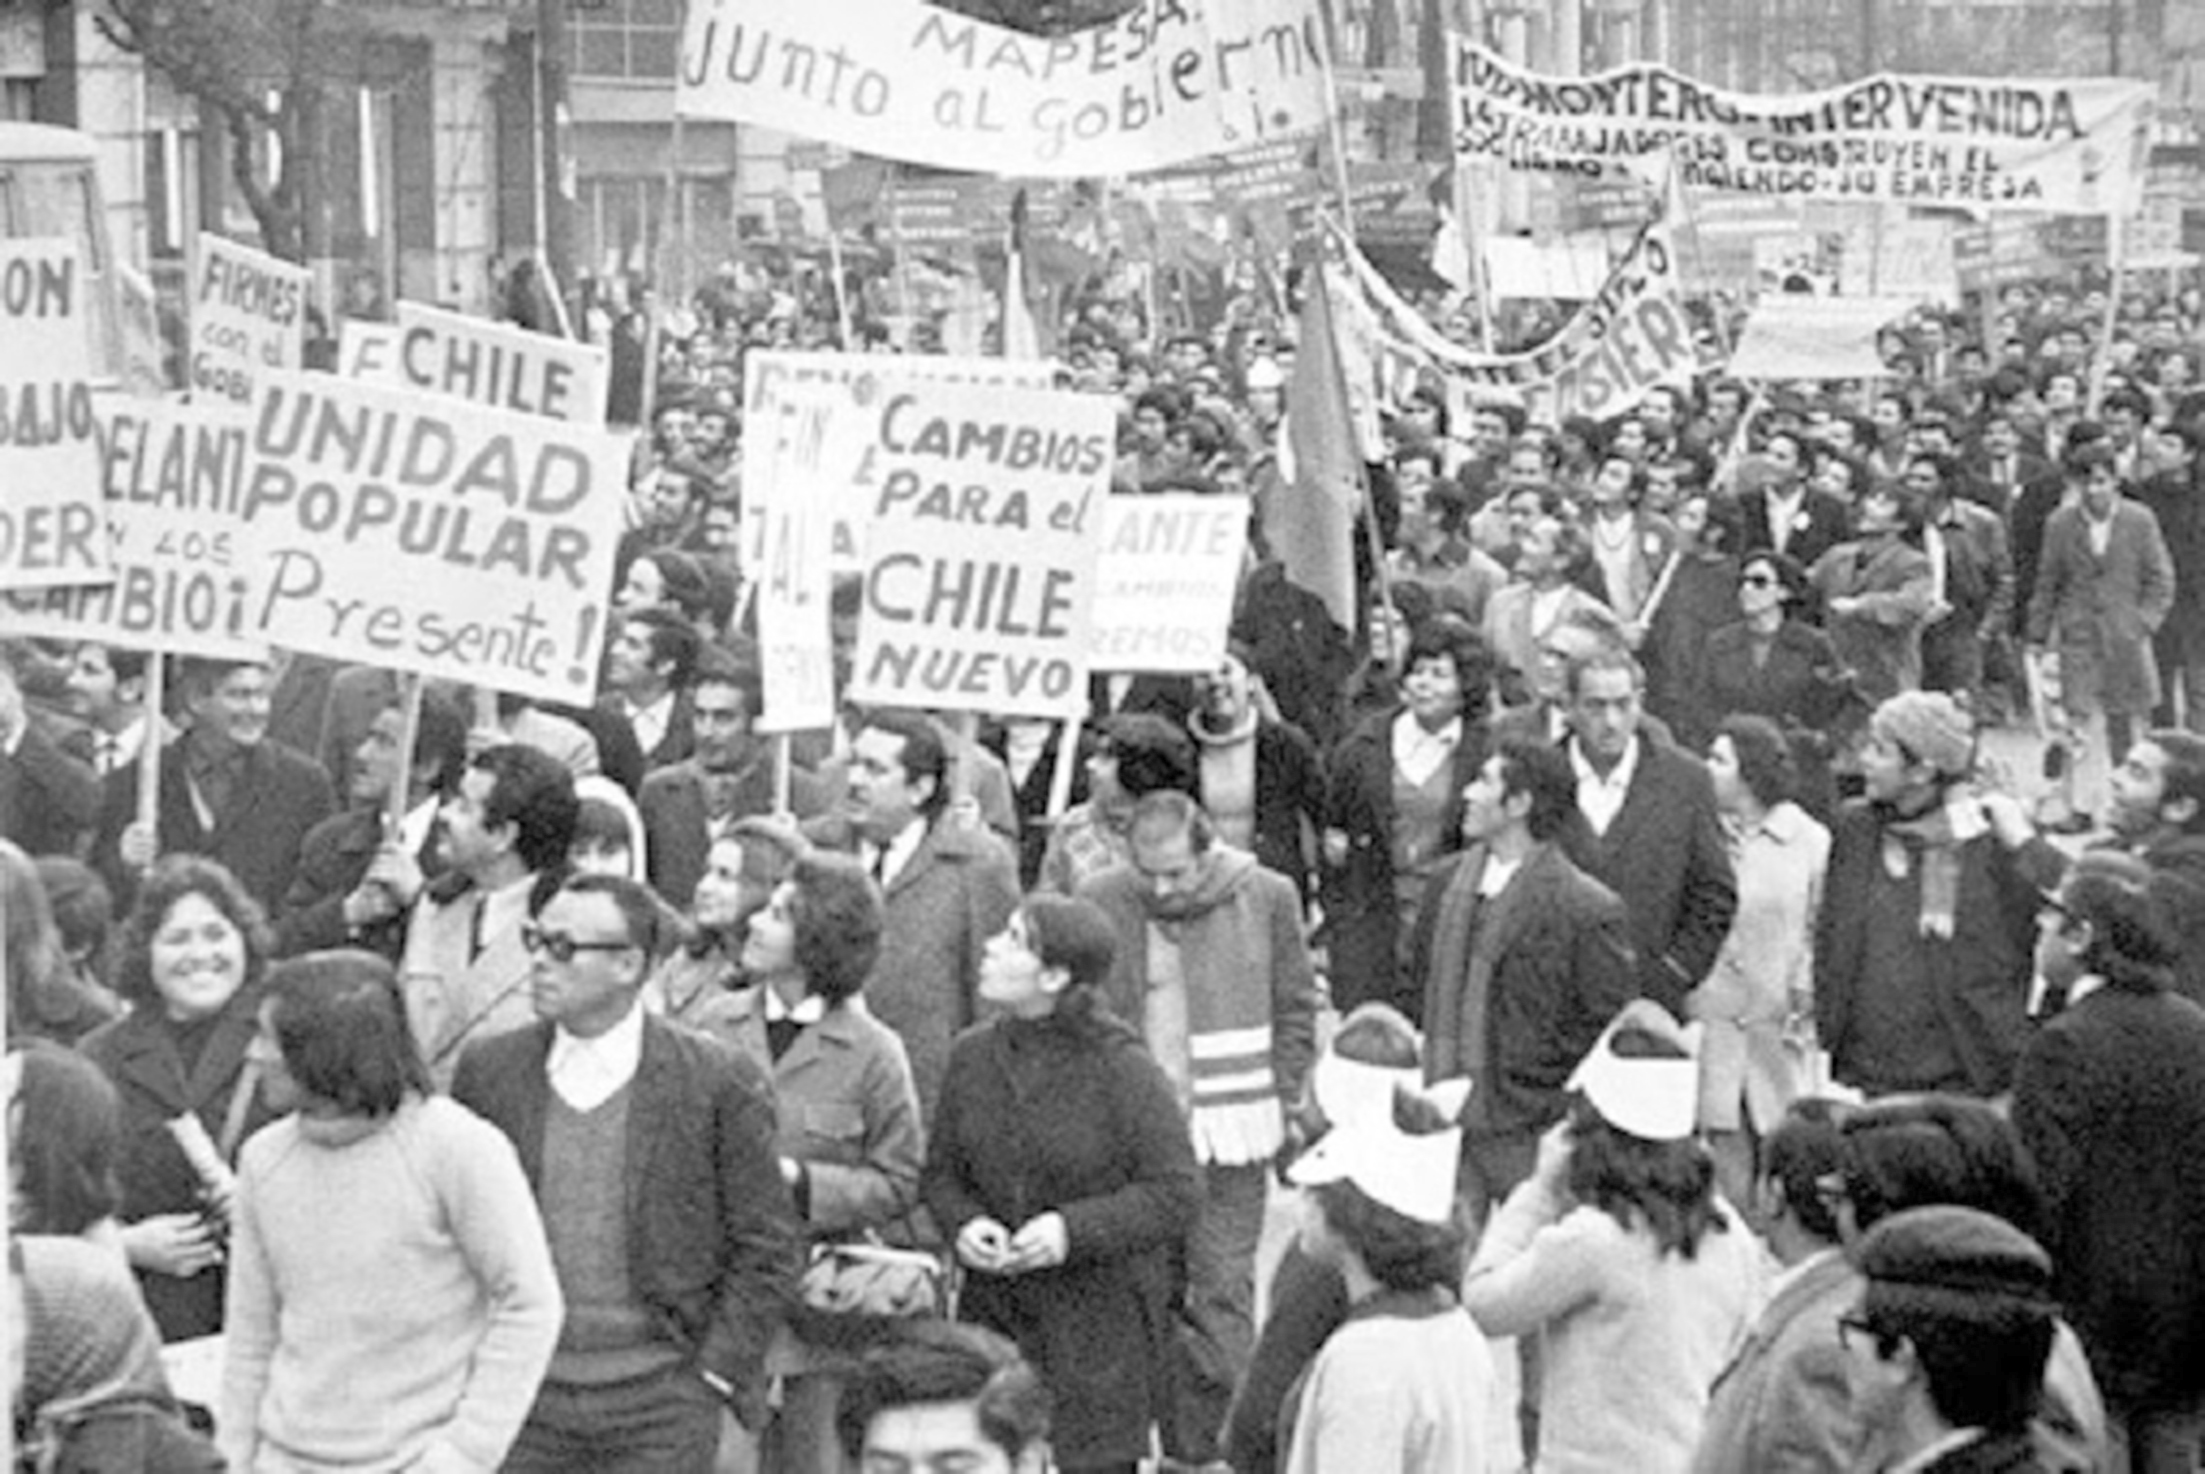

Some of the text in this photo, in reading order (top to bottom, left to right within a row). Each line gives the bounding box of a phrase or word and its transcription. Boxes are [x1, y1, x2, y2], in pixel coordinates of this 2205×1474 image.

[1891, 169, 2043, 200] EMPRESA
[1966, 147, 1999, 172] EL
[199, 252, 298, 328] FIRMES
[201, 322, 248, 357] con
[402, 327, 573, 421] CHILE
[254, 386, 593, 515] UNIDAD
[880, 393, 1106, 475] CAMBIOS
[242, 462, 593, 591] POPULAR
[875, 468, 1094, 534] PARA el
[866, 552, 1074, 638] CHILE
[867, 641, 1073, 699] NUEVO
